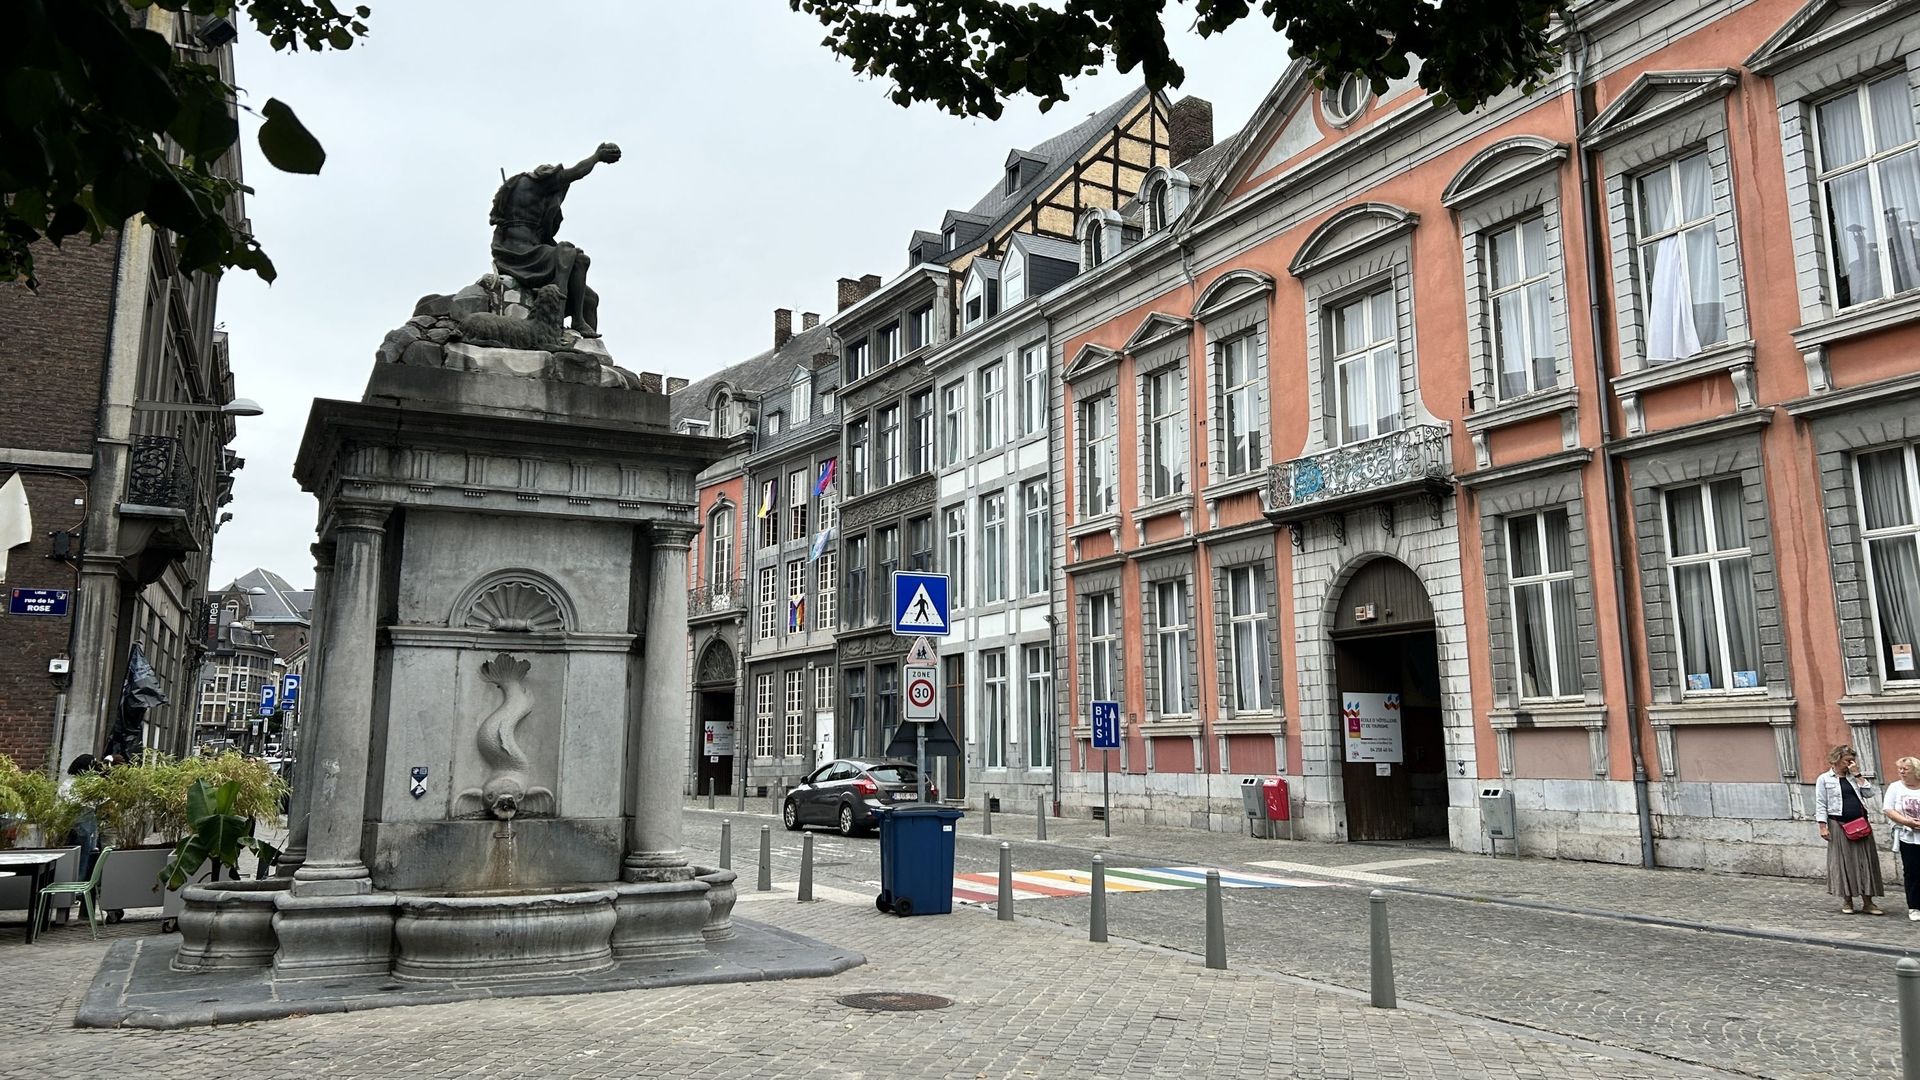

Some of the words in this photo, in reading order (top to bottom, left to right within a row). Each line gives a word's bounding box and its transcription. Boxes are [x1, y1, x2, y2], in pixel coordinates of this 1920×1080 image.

[284, 678, 298, 696] P
[914, 688, 929, 699] 30
[262, 688, 274, 704] P
[1095, 706, 1103, 739] BUS
